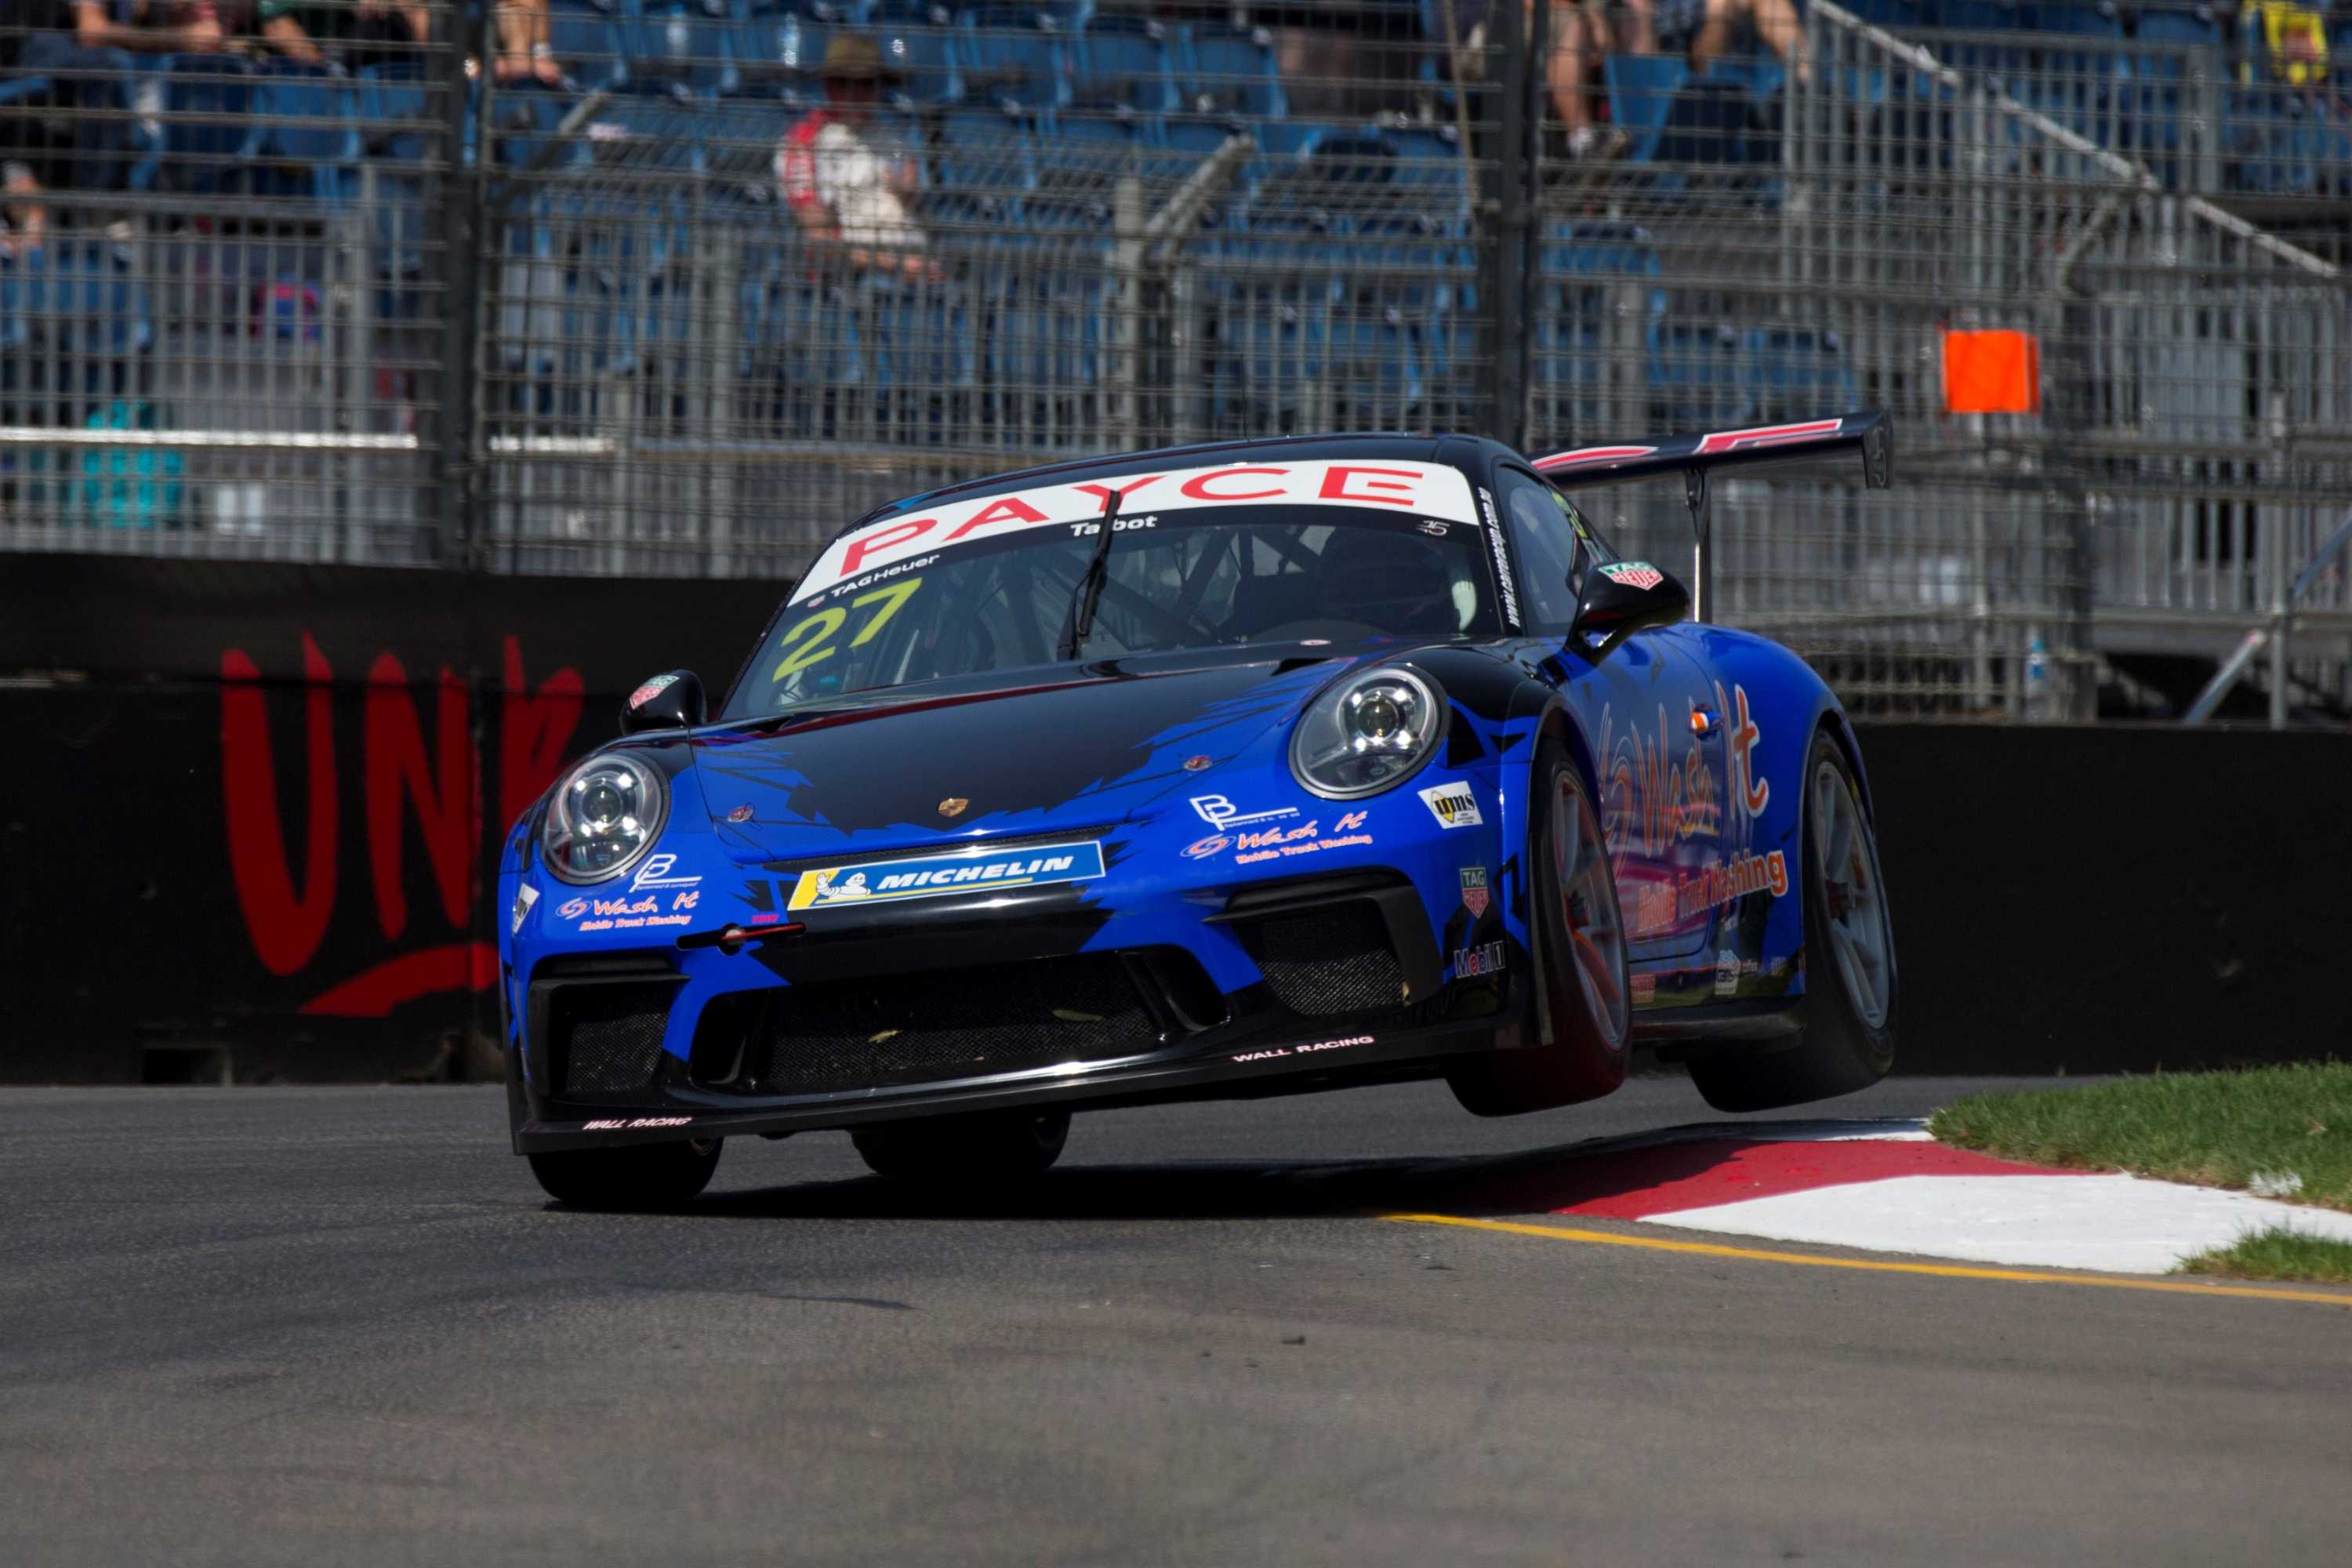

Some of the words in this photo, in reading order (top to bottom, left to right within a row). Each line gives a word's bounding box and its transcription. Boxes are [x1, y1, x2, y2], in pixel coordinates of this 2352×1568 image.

[840, 466, 1423, 576] PAYCE
[1070, 516, 1157, 536] Tabot
[772, 578, 922, 682] 27
[1236, 820, 1317, 850] Wash
[877, 856, 1073, 890] MICHELIN
[1463, 871, 1485, 886] TAG
[593, 895, 658, 916] Wash
[1454, 943, 1493, 978] Mobil
[1232, 1049, 1292, 1062] WALL
[1296, 1036, 1374, 1053] RACING
[583, 1120, 626, 1131] WALL
[627, 1116, 692, 1128] RACING
